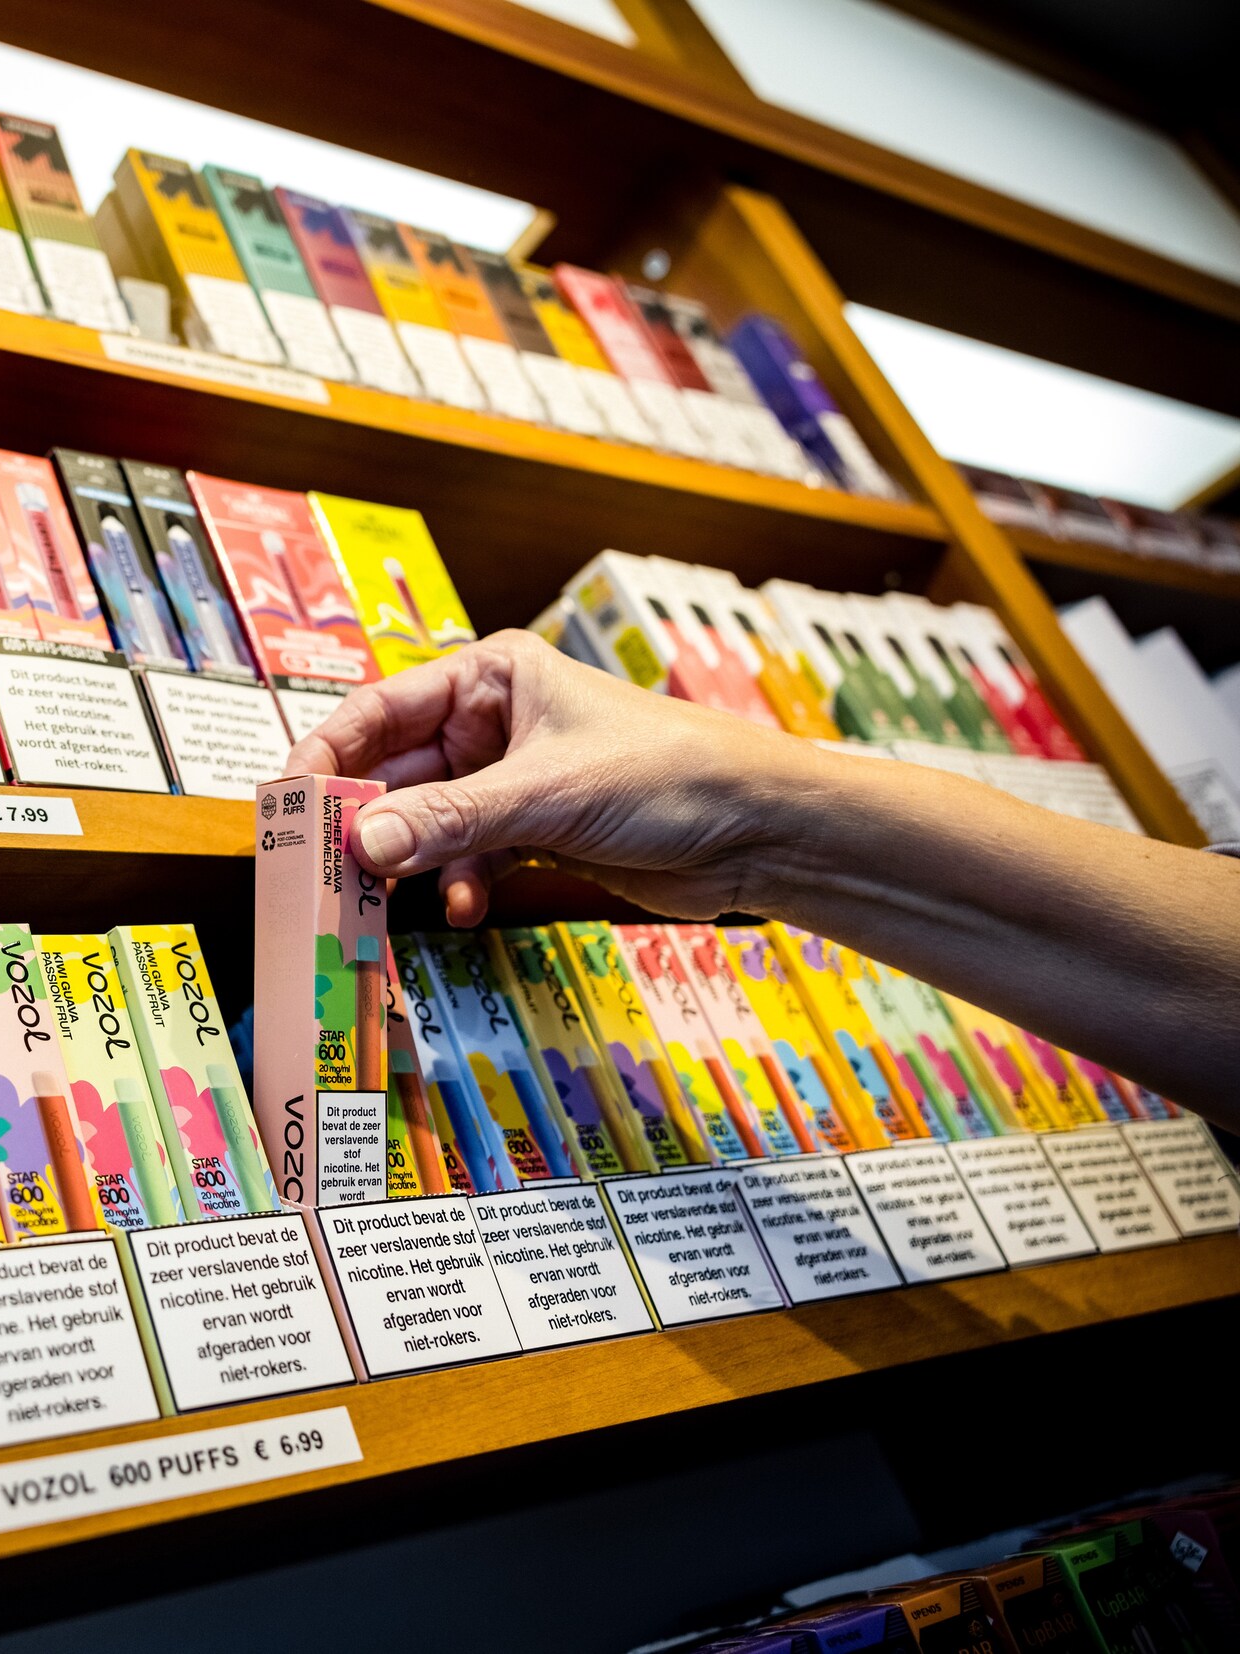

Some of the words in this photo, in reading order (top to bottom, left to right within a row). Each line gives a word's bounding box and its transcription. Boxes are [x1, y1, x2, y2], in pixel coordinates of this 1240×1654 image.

[283, 790, 306, 806] 600
[6, 807, 48, 823] 7,99
[283, 804, 305, 816] PUFFS
[333, 796, 342, 846] LYCHEE
[323, 795, 332, 886] WATERMELON
[333, 846, 343, 894] GUAVA
[132, 942, 153, 991] PASSION
[146, 992, 165, 1027] FRUIT
[143, 942, 158, 969] KIWI
[152, 969, 170, 1011] GUAVA
[41, 952, 62, 1002] PASSION
[56, 1004, 73, 1040] FRUIT
[53, 952, 67, 979] KIWI
[61, 980, 79, 1024] GUAVA
[319, 1030, 345, 1041] STAR
[319, 1044, 345, 1061] 600
[319, 1074, 352, 1084] nicotine
[330, 1064, 350, 1077] mg/ml
[327, 1107, 340, 1116] Dit
[342, 1107, 376, 1119] product
[322, 1121, 347, 1130] bevat
[349, 1121, 360, 1130] de
[284, 1095, 304, 1204] VOZO
[325, 1134, 379, 1144] verslavende
[192, 1157, 221, 1169] STAR
[343, 1149, 361, 1158] stof
[324, 1163, 363, 1173] nicotine.
[365, 1162, 380, 1172] Het
[95, 1174, 125, 1186] STAR
[196, 1171, 226, 1187] 600
[321, 1177, 356, 1190] gebruik
[358, 1178, 382, 1186] ervan
[98, 1187, 129, 1205] 600
[201, 1192, 210, 1200] 20
[211, 1189, 235, 1203] mg/ml
[204, 1199, 240, 1211] nicotine
[340, 1191, 365, 1201] wordt
[477, 1206, 497, 1221] Dit
[501, 1200, 548, 1223] product
[550, 1196, 580, 1211] bevat
[582, 1195, 596, 1208] de
[333, 1218, 355, 1234] Dit
[358, 1213, 411, 1235] product
[412, 1209, 448, 1225] bevat
[450, 1208, 466, 1221] de
[482, 1228, 511, 1243] zeer
[513, 1218, 585, 1239] verslavende
[587, 1215, 607, 1229] stof
[338, 1245, 368, 1258] zeer
[371, 1232, 451, 1254] verslavende
[454, 1230, 477, 1245] stof
[493, 1247, 548, 1266] nicotine.
[551, 1243, 570, 1257] Het
[572, 1237, 615, 1258] gebruik
[348, 1263, 408, 1282] nicotine.
[410, 1259, 436, 1275] Het
[438, 1253, 484, 1275] gebruik
[530, 1269, 565, 1284] ervan
[566, 1262, 601, 1278] wordt
[386, 1287, 426, 1302] ervan
[427, 1279, 466, 1297] wordt
[528, 1288, 589, 1310] afgeraden
[591, 1284, 617, 1298] voor
[383, 1307, 452, 1331] afgeraden
[453, 1304, 483, 1318] voor
[548, 1308, 617, 1330] niet-rokers.
[404, 1330, 480, 1352] niet-rokers.
[1, 1473, 96, 1507] VOZOL
[109, 1461, 152, 1489] 600
[159, 1445, 239, 1480] PUFFS
[254, 1440, 268, 1460] €
